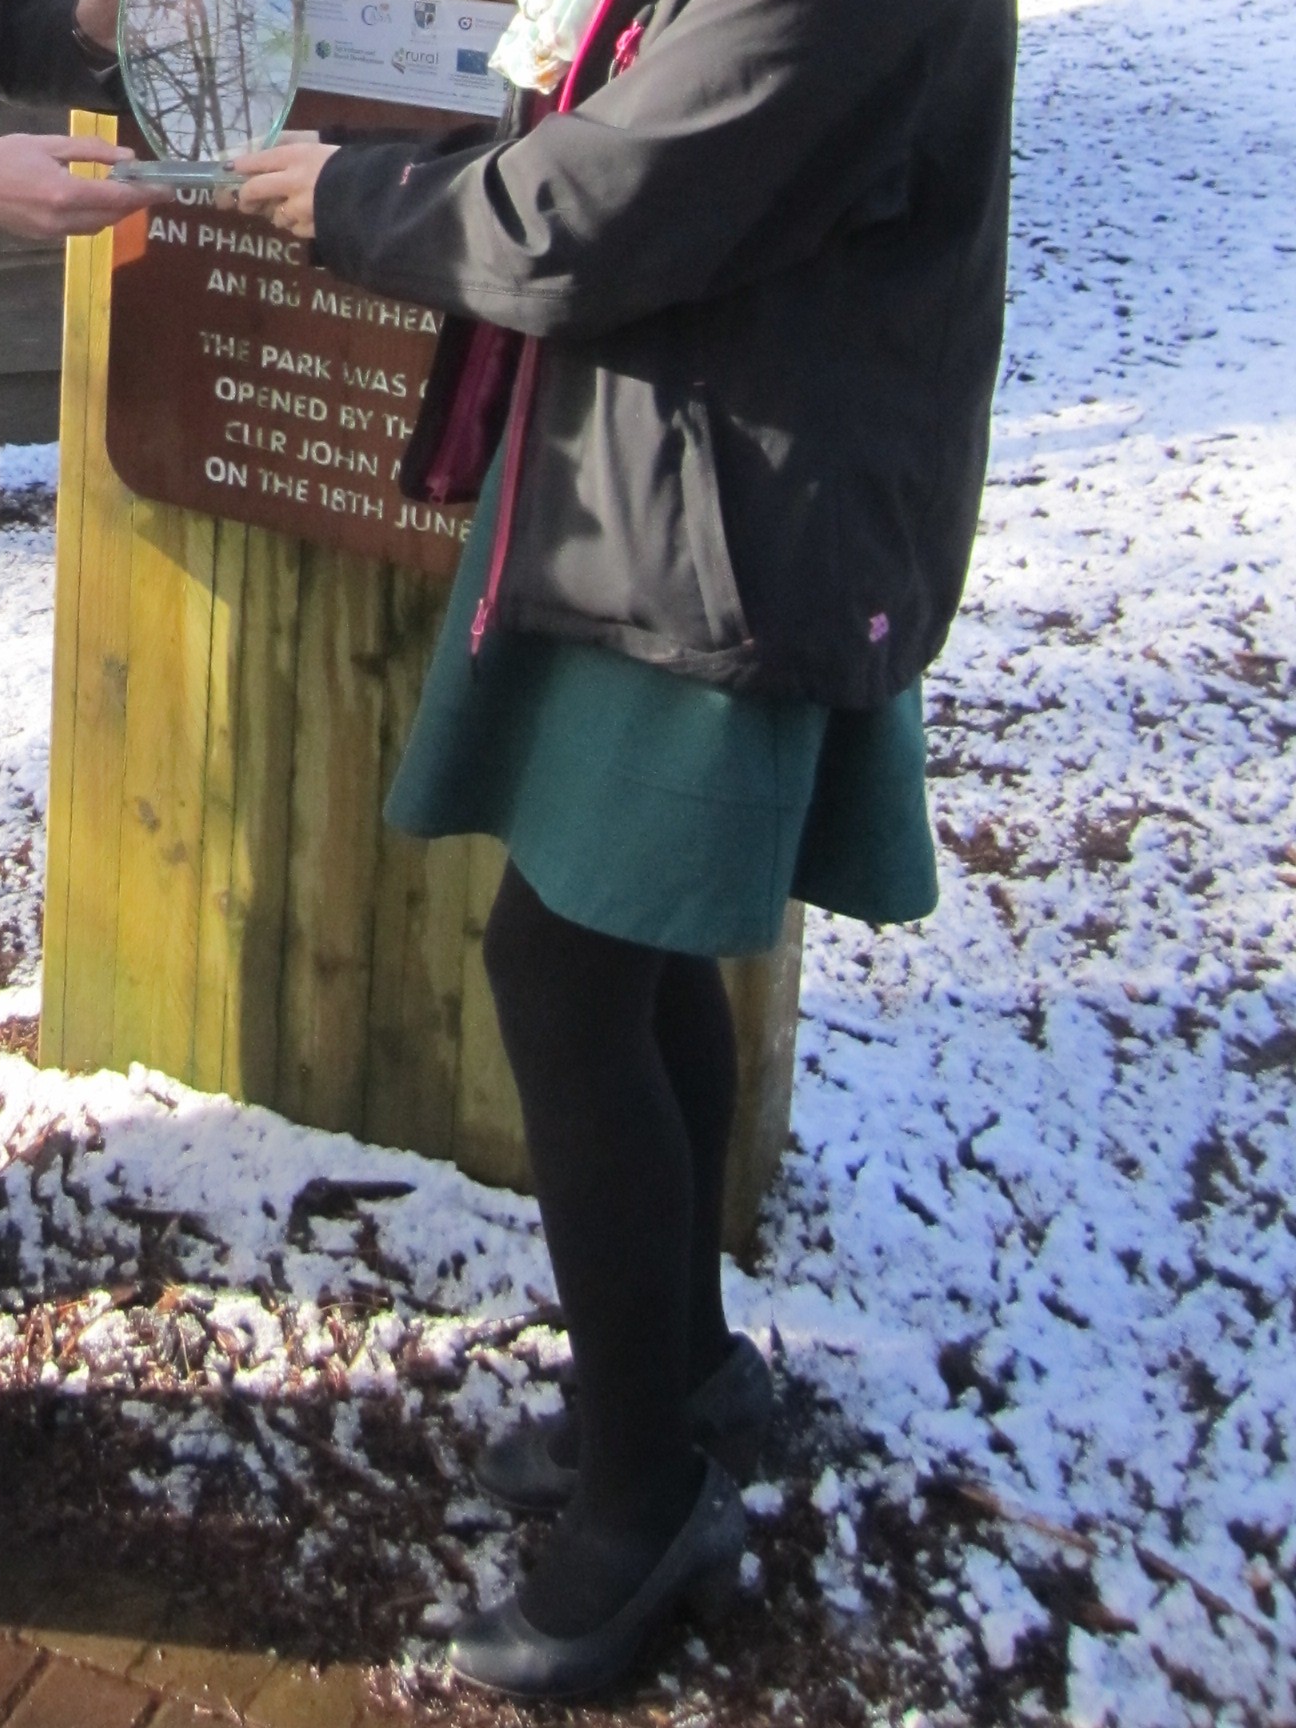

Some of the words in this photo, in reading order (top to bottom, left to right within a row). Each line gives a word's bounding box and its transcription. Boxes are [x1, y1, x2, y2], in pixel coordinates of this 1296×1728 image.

[405, 49, 440, 66] rural
[148, 215, 187, 247] AN
[207, 268, 247, 296] AN
[311, 288, 445, 335] MEITHEA
[200, 331, 250, 362] THE
[261, 345, 332, 381] PARK
[343, 362, 407, 398] WAS
[215, 376, 328, 422] OPENED
[340, 405, 374, 431] BY
[297, 439, 378, 477] JOHN
[205, 456, 248, 488] ON
[258, 468, 309, 504] THE
[319, 483, 383, 520] 18TH
[395, 503, 472, 543] JUNE
